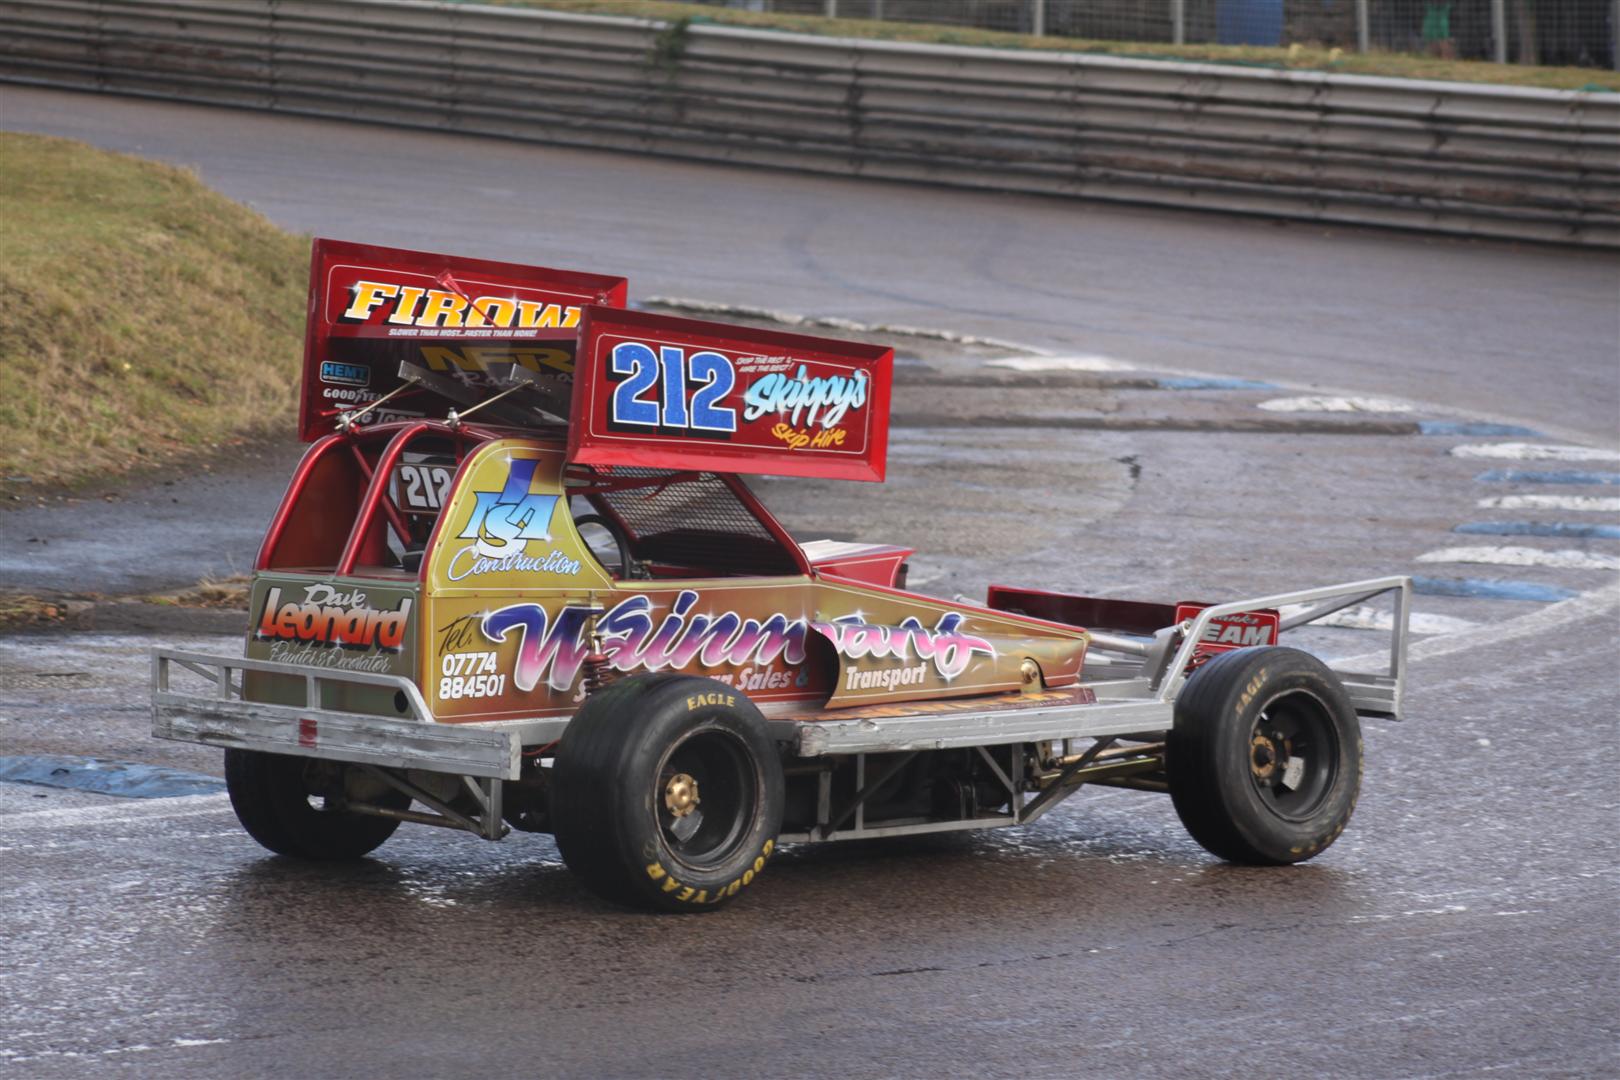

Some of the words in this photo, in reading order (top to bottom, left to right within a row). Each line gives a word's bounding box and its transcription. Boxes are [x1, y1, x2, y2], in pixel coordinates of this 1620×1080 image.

[420, 329, 439, 337] THAN
[611, 341, 737, 432] 212
[772, 422, 810, 450] Skip
[811, 428, 847, 449] Hire
[447, 545, 581, 580] Construction
[304, 583, 367, 608] Dave
[256, 587, 413, 648] Leonard
[441, 652, 497, 678] 07774
[735, 664, 792, 691] Sales
[845, 662, 928, 691] Transport
[439, 674, 505, 700] 884501
[686, 693, 735, 712] EAGLE
